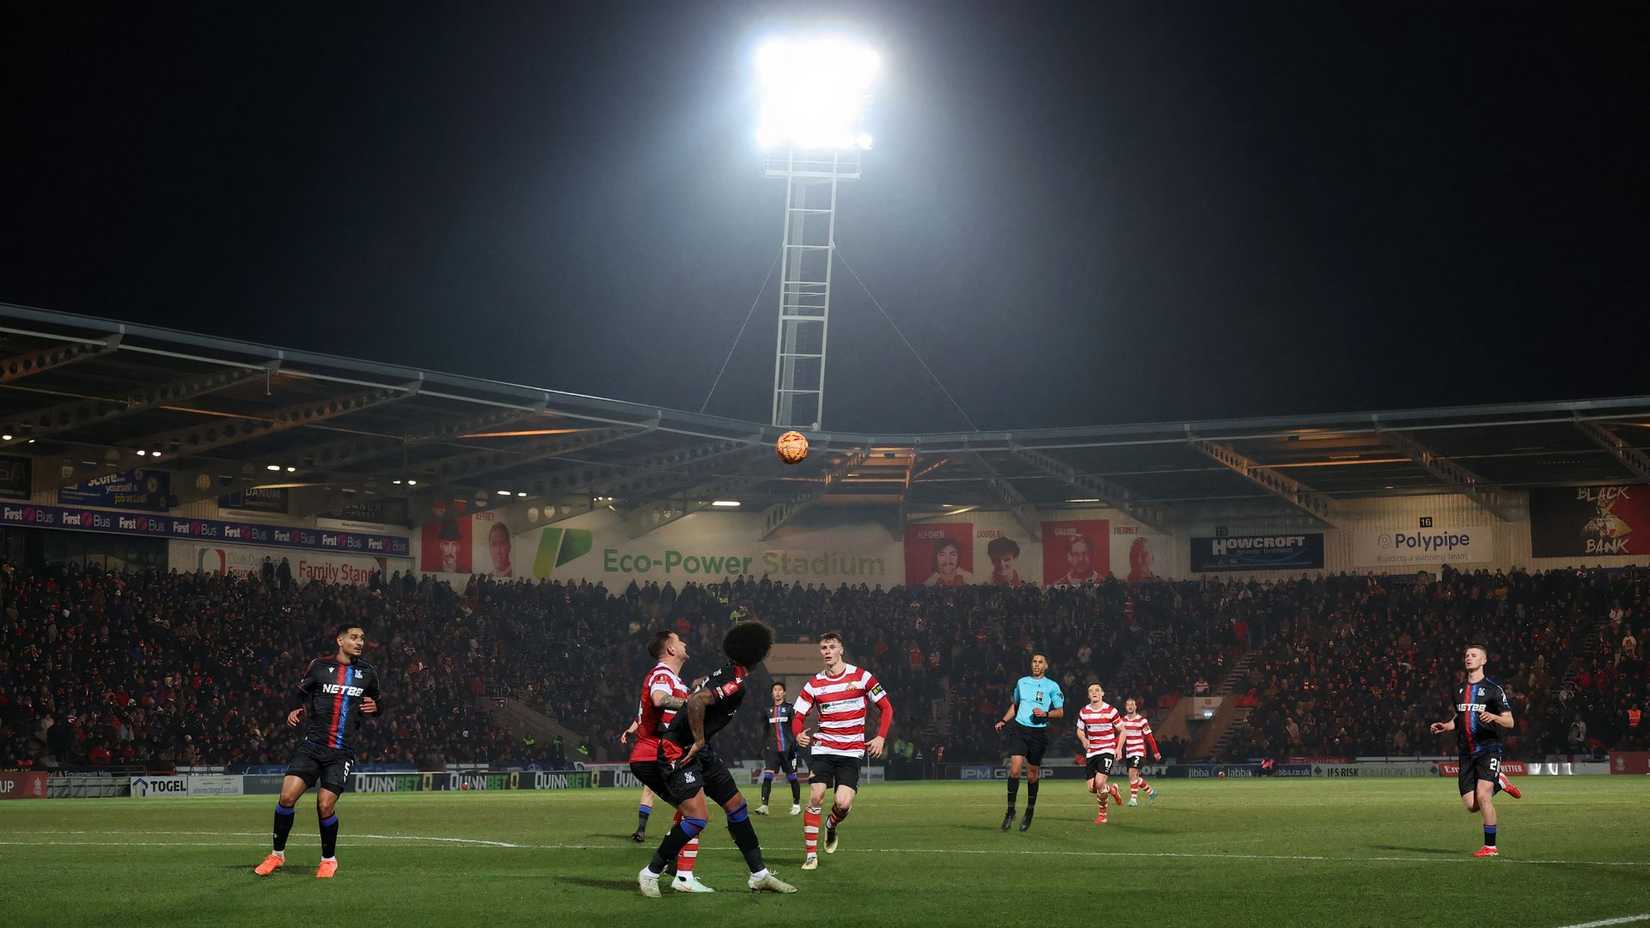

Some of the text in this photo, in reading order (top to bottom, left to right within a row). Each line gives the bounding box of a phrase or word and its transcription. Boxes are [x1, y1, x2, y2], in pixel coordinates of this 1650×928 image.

[1576, 487, 1631, 502] BLACK
[4, 507, 53, 523] First Bus
[62, 512, 111, 528] First Bus
[119, 516, 137, 530] First
[173, 521, 217, 537] First Bus
[224, 526, 241, 538] First
[274, 530, 290, 542] First
[322, 534, 337, 546] First
[368, 538, 383, 550] First
[1212, 536, 1304, 555] HOWCROFT
[1395, 531, 1470, 551] Polypipe
[1585, 539, 1630, 553] BANK
[604, 549, 885, 576] Eco-Power Stadium
[299, 560, 339, 584] Family
[150, 781, 186, 792] TOGEL
[355, 773, 418, 793] QUINNBET
[451, 770, 508, 790] QUINNBET
[535, 770, 591, 789] QUINNBET
